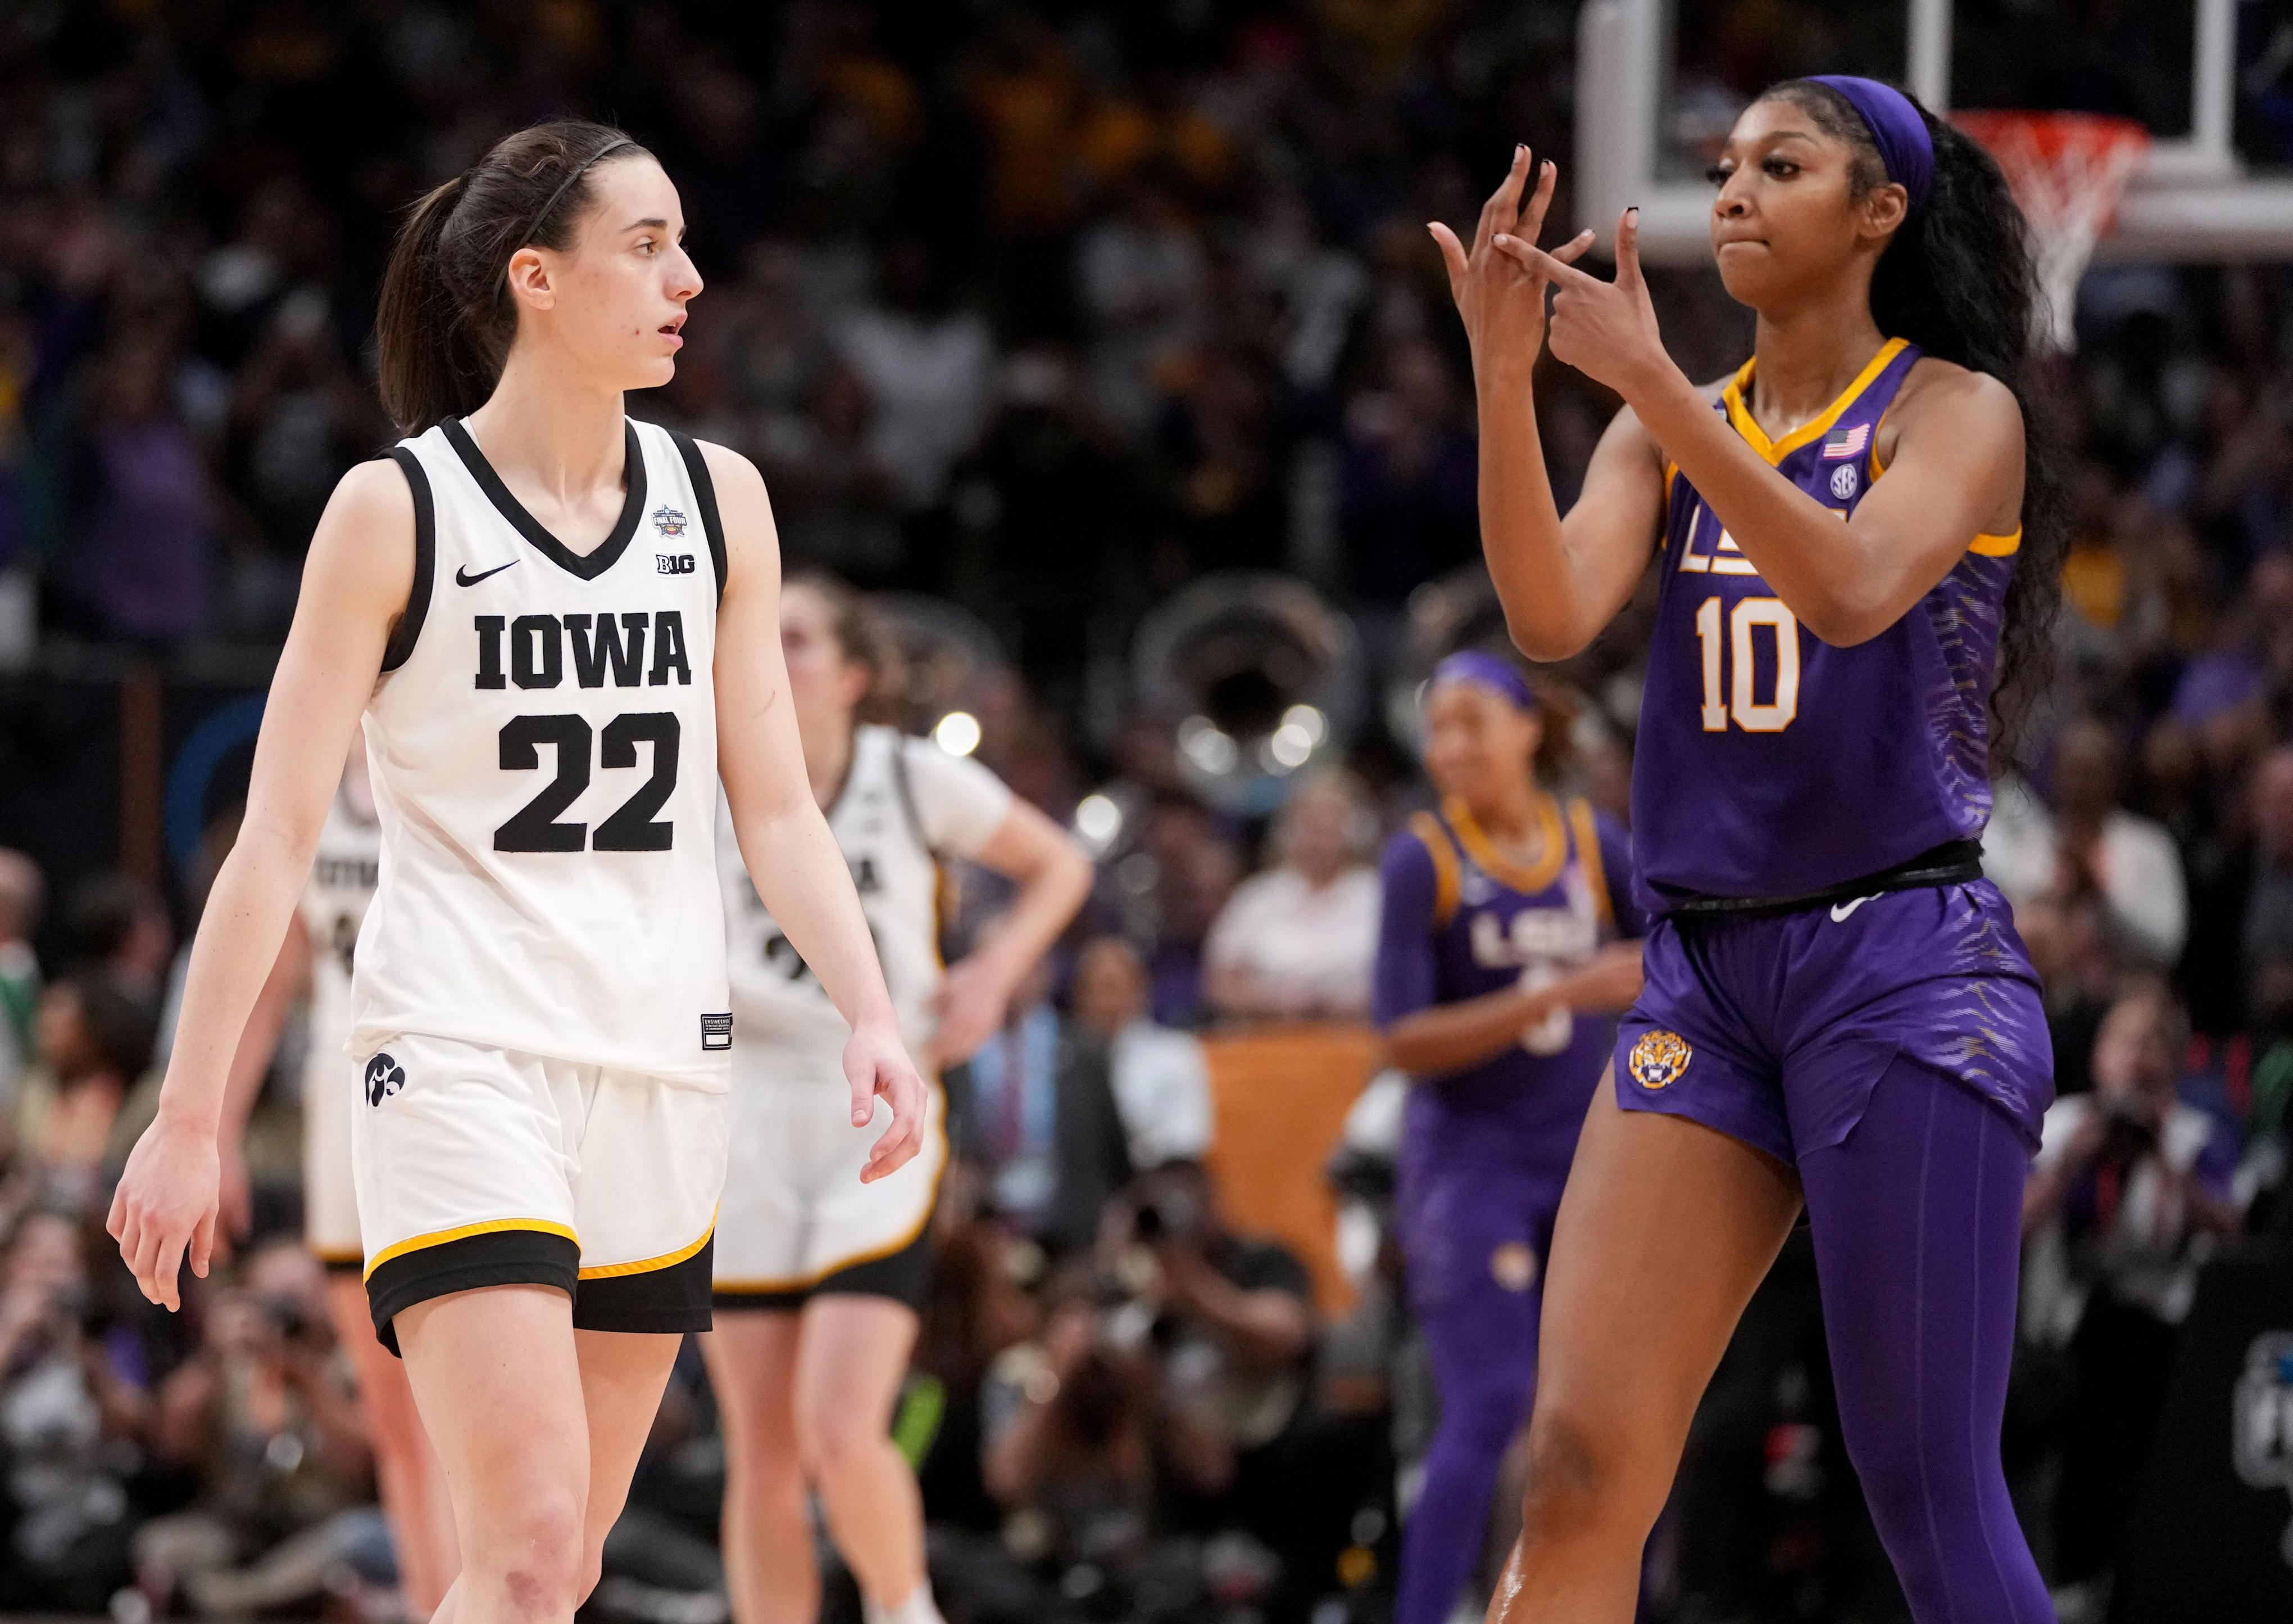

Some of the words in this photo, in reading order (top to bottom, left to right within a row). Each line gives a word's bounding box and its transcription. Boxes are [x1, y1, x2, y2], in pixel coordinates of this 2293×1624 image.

[1832, 466, 1856, 495] SEC
[653, 516, 669, 525] FINAL
[669, 516, 686, 525] FOUR
[475, 611, 692, 689] IOWA
[1696, 596, 1800, 733] 10
[494, 711, 681, 852] 22
